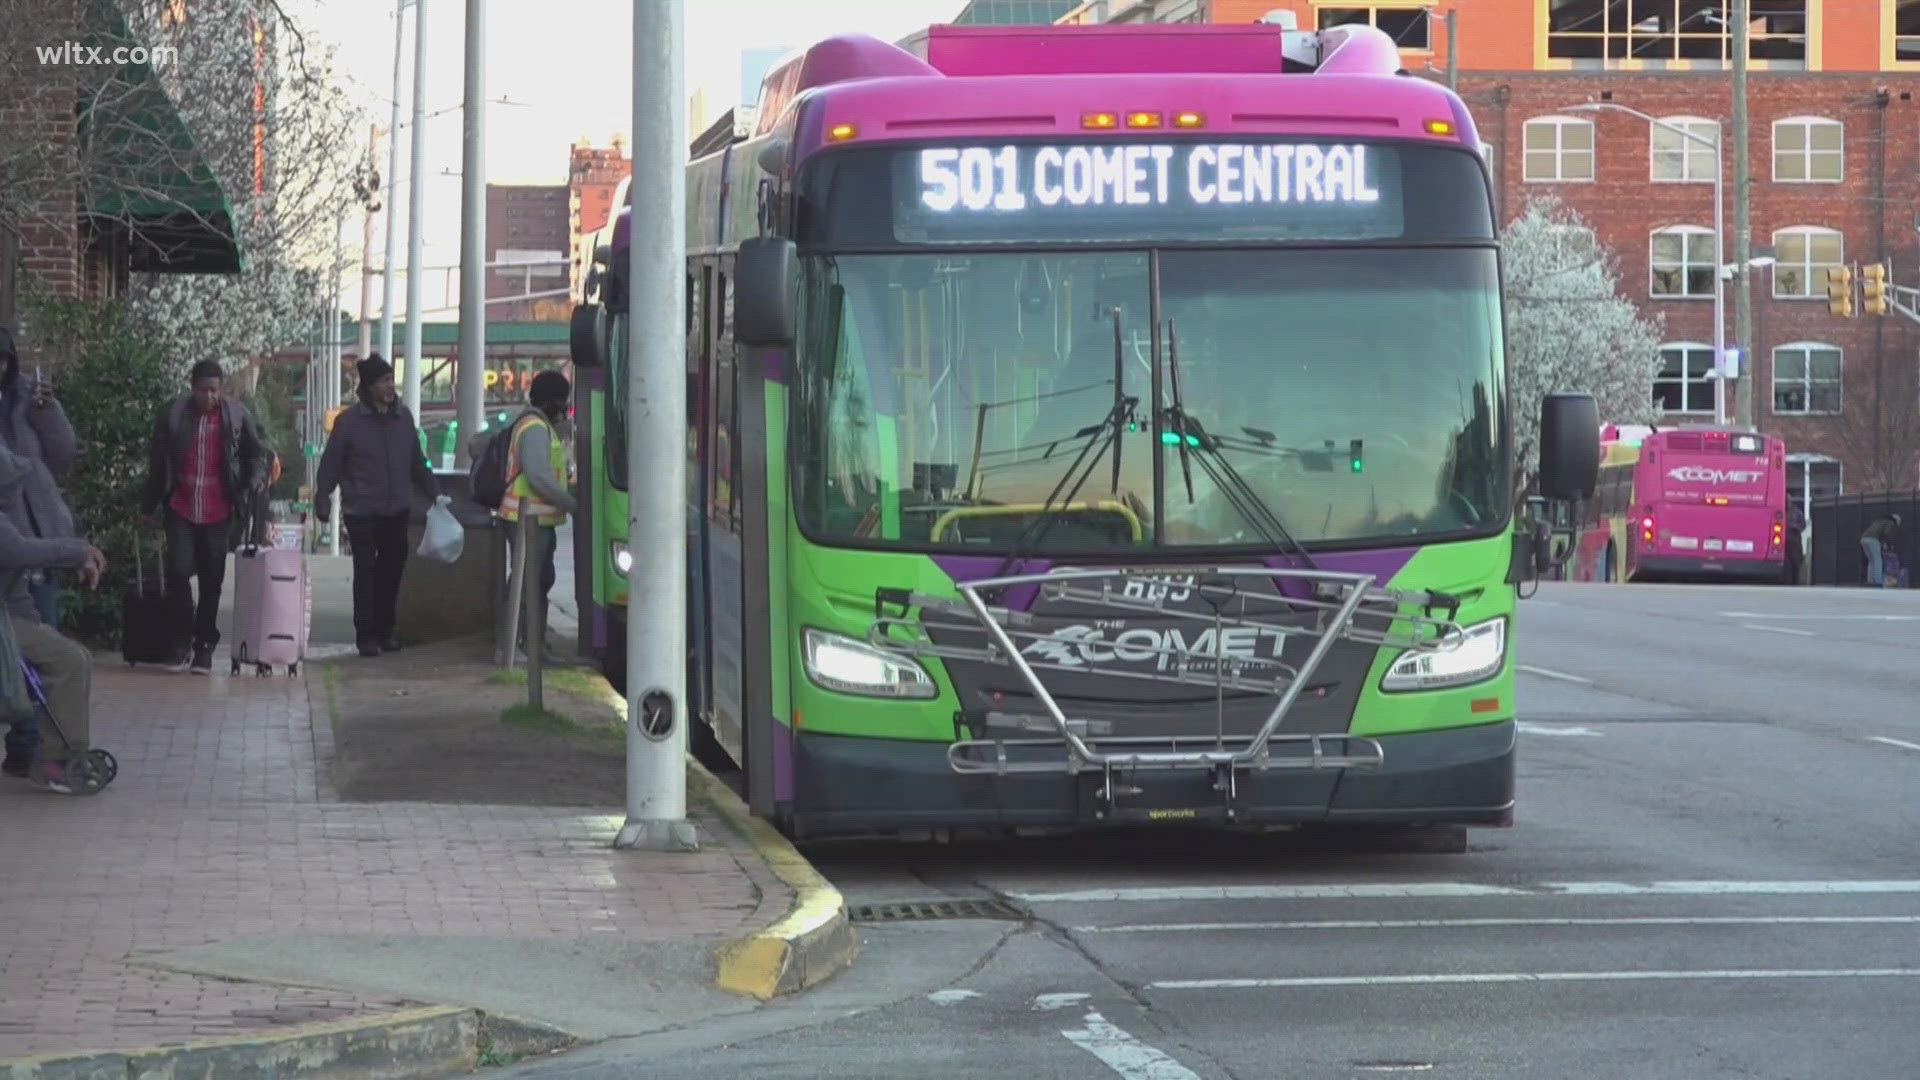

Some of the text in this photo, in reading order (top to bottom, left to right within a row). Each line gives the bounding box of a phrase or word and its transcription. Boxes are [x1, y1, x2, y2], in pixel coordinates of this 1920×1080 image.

[921, 144, 1379, 211] 501 COMET CENTRAL
[1683, 467, 1764, 485] COMET
[1094, 619, 1126, 629] THE
[1077, 627, 1299, 671] COMET
